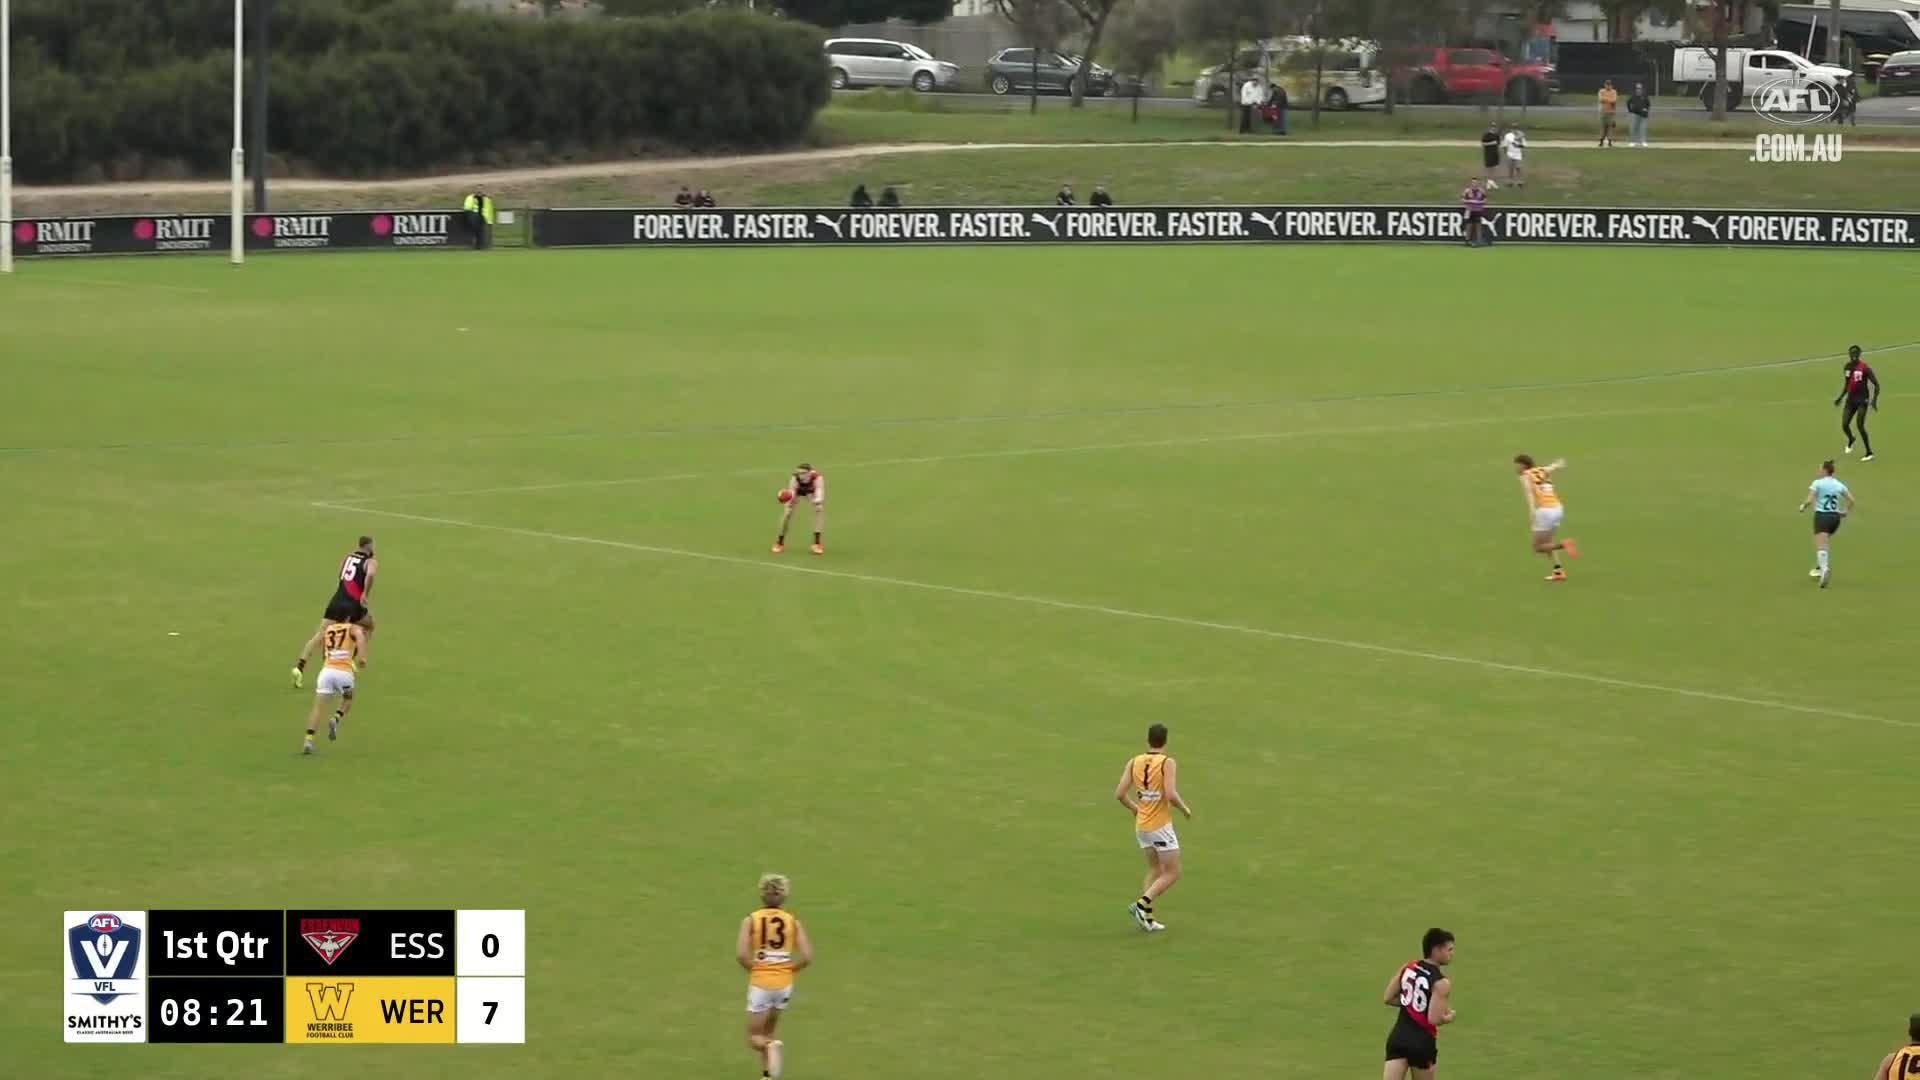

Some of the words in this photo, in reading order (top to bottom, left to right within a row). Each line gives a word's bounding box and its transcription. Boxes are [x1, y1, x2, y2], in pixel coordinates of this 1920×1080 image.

[37, 221, 95, 242] RMIT
[155, 218, 214, 239] RMIT
[273, 216, 332, 237] RMIT
[392, 214, 450, 235] RMIT
[634, 214, 729, 239] FOREVER.
[733, 214, 815, 239] FASTER.
[850, 213, 946, 238] FOREVER.
[950, 213, 1031, 238] FASTER.
[1066, 212, 1164, 237] FOREVER.
[1167, 212, 1250, 237] FASTER.
[1285, 211, 1383, 236] FOREVER.
[1505, 212, 1604, 238] FOREVER.
[1608, 214, 1691, 240] FASTER.
[1727, 215, 1826, 242] FOREVER.
[1831, 217, 1916, 244] FASTER.
[1823, 494, 1838, 511] 26
[340, 555, 361, 582] 15
[327, 628, 347, 650] 37
[760, 916, 785, 949] 13
[1400, 967, 1430, 1013] 56
